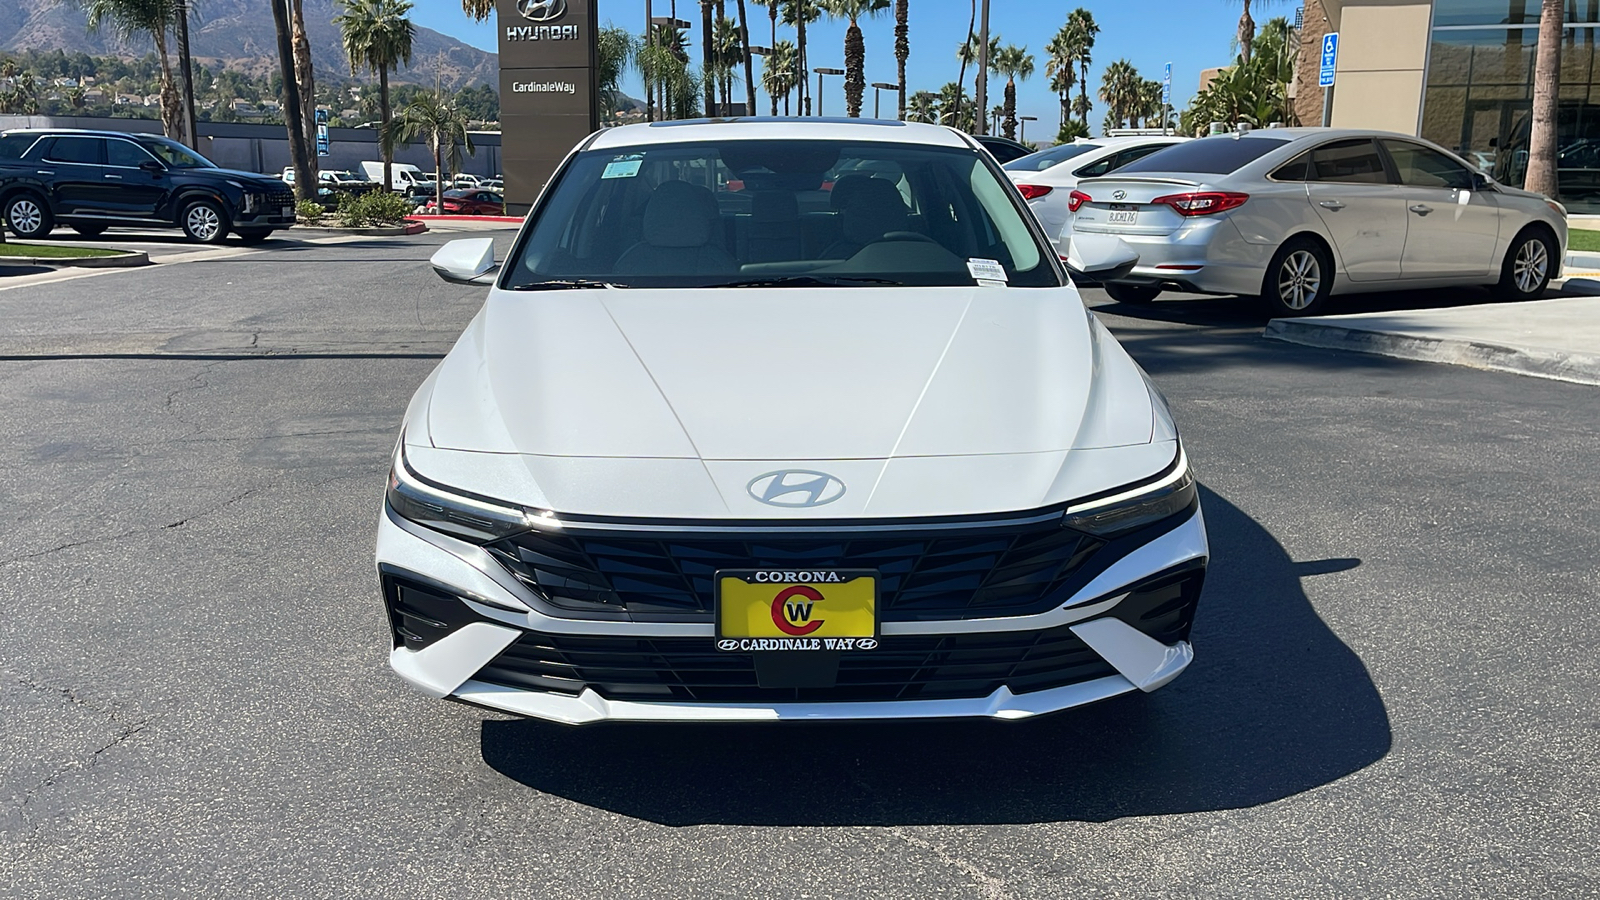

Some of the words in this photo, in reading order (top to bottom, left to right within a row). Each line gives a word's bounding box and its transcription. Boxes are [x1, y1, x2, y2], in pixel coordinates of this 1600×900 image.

[506, 25, 578, 41] HYUNDAI
[512, 81, 575, 94] CardinaleWay
[755, 571, 840, 583] CORONA
[740, 638, 821, 651] CARDINALE
[823, 638, 856, 651] WAY
